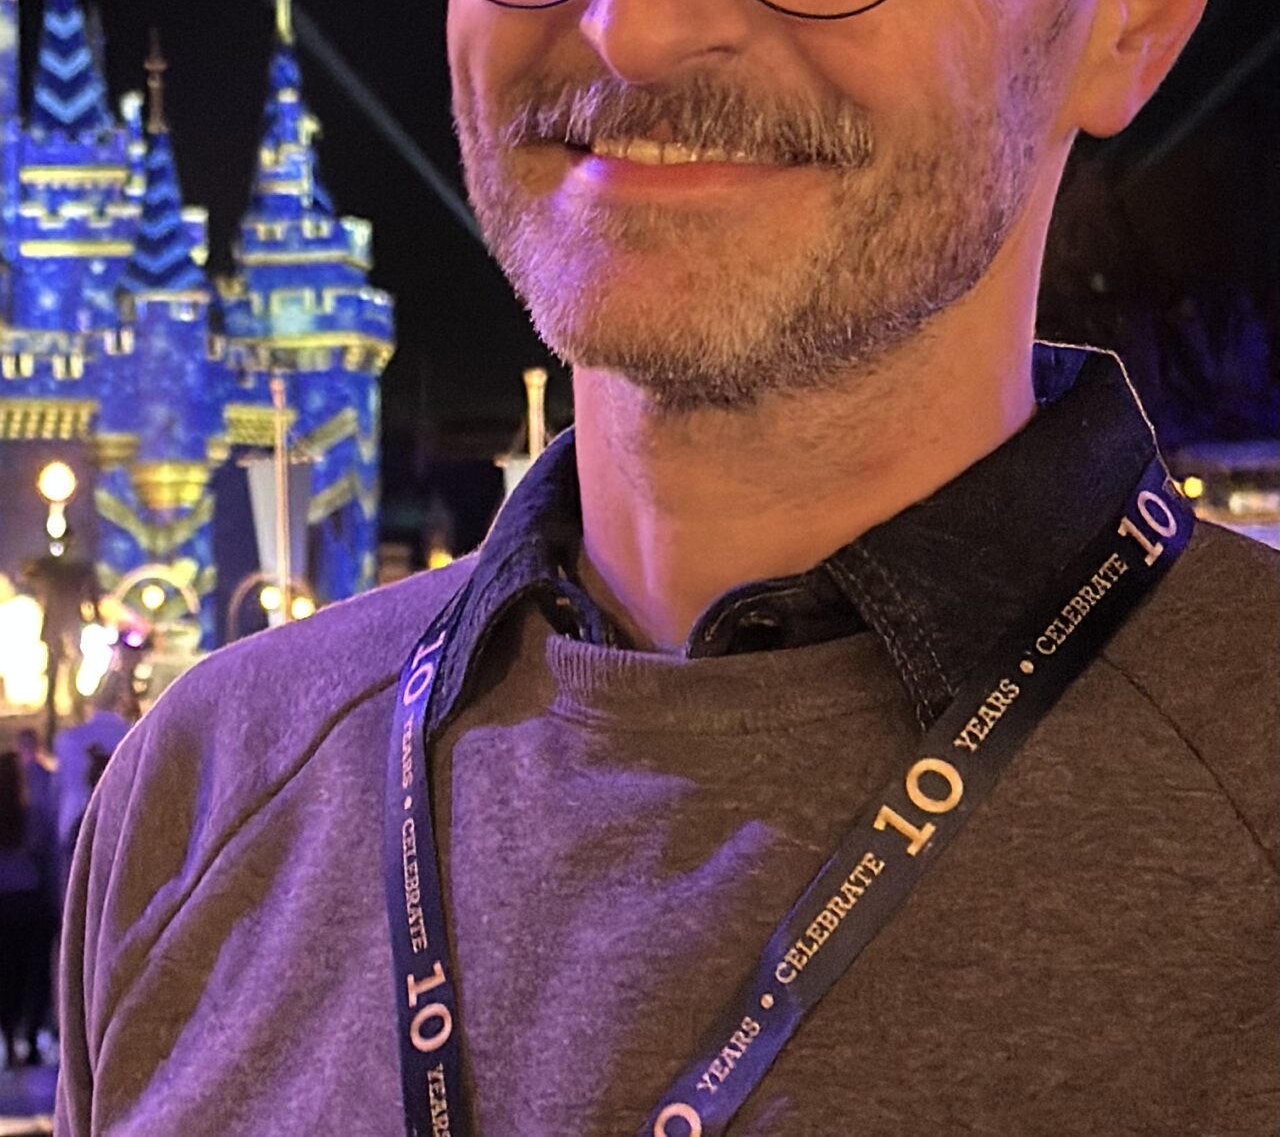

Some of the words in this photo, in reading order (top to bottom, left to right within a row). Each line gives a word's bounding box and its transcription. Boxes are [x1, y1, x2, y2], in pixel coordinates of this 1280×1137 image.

[403, 630, 447, 706] 10
[653, 1102, 702, 1137] 0
[695, 1015, 760, 1094] YEARS
[775, 851, 886, 984] CELEBRATE
[873, 757, 964, 857] 10
[952, 678, 1020, 752] YEARS
[1035, 552, 1129, 655] CELEBRATE
[1117, 490, 1177, 567] 10
[402, 817, 428, 954] CELEBRATE
[407, 960, 453, 1053] 10
